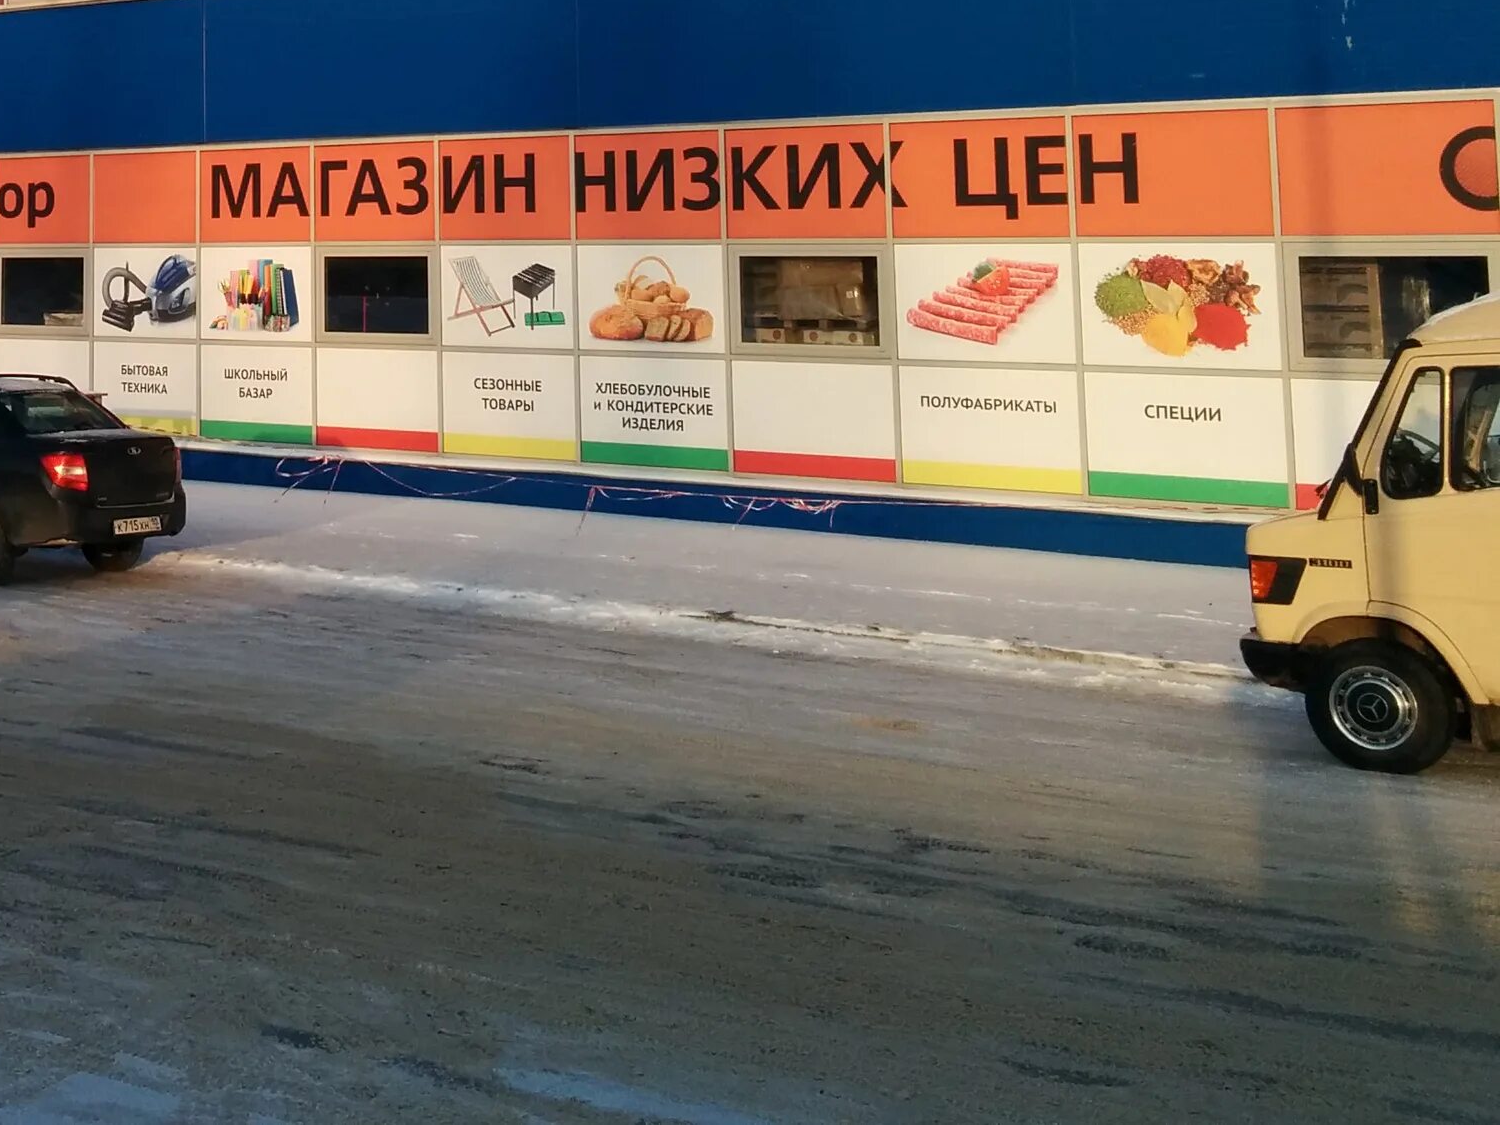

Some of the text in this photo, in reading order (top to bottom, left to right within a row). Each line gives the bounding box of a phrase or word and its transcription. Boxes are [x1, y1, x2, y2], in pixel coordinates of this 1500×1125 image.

[210, 132, 1140, 220] МАГАЗИН НИЗКИХ ЦЕН
[121, 364, 168, 376] БЫТОВАЯ
[224, 368, 288, 382] ШКОЛЬНЫЙ
[121, 382, 168, 394] ТЕХНИКА
[473, 377, 542, 392] СЕЗОННЫЕ
[595, 382, 711, 398] ХЛЕБОБУЛОЧНЫЕ
[238, 387, 273, 399] БАЗАР
[481, 397, 534, 412] ТОВАРЫ
[607, 399, 714, 416] КОНДИТЕРСКИЕ
[920, 395, 1057, 414] ПОЛУФАБРИКАТЫ
[1144, 404, 1222, 423] СПЕЦИИ
[621, 417, 684, 431] ИЗДЕЛИЯ
